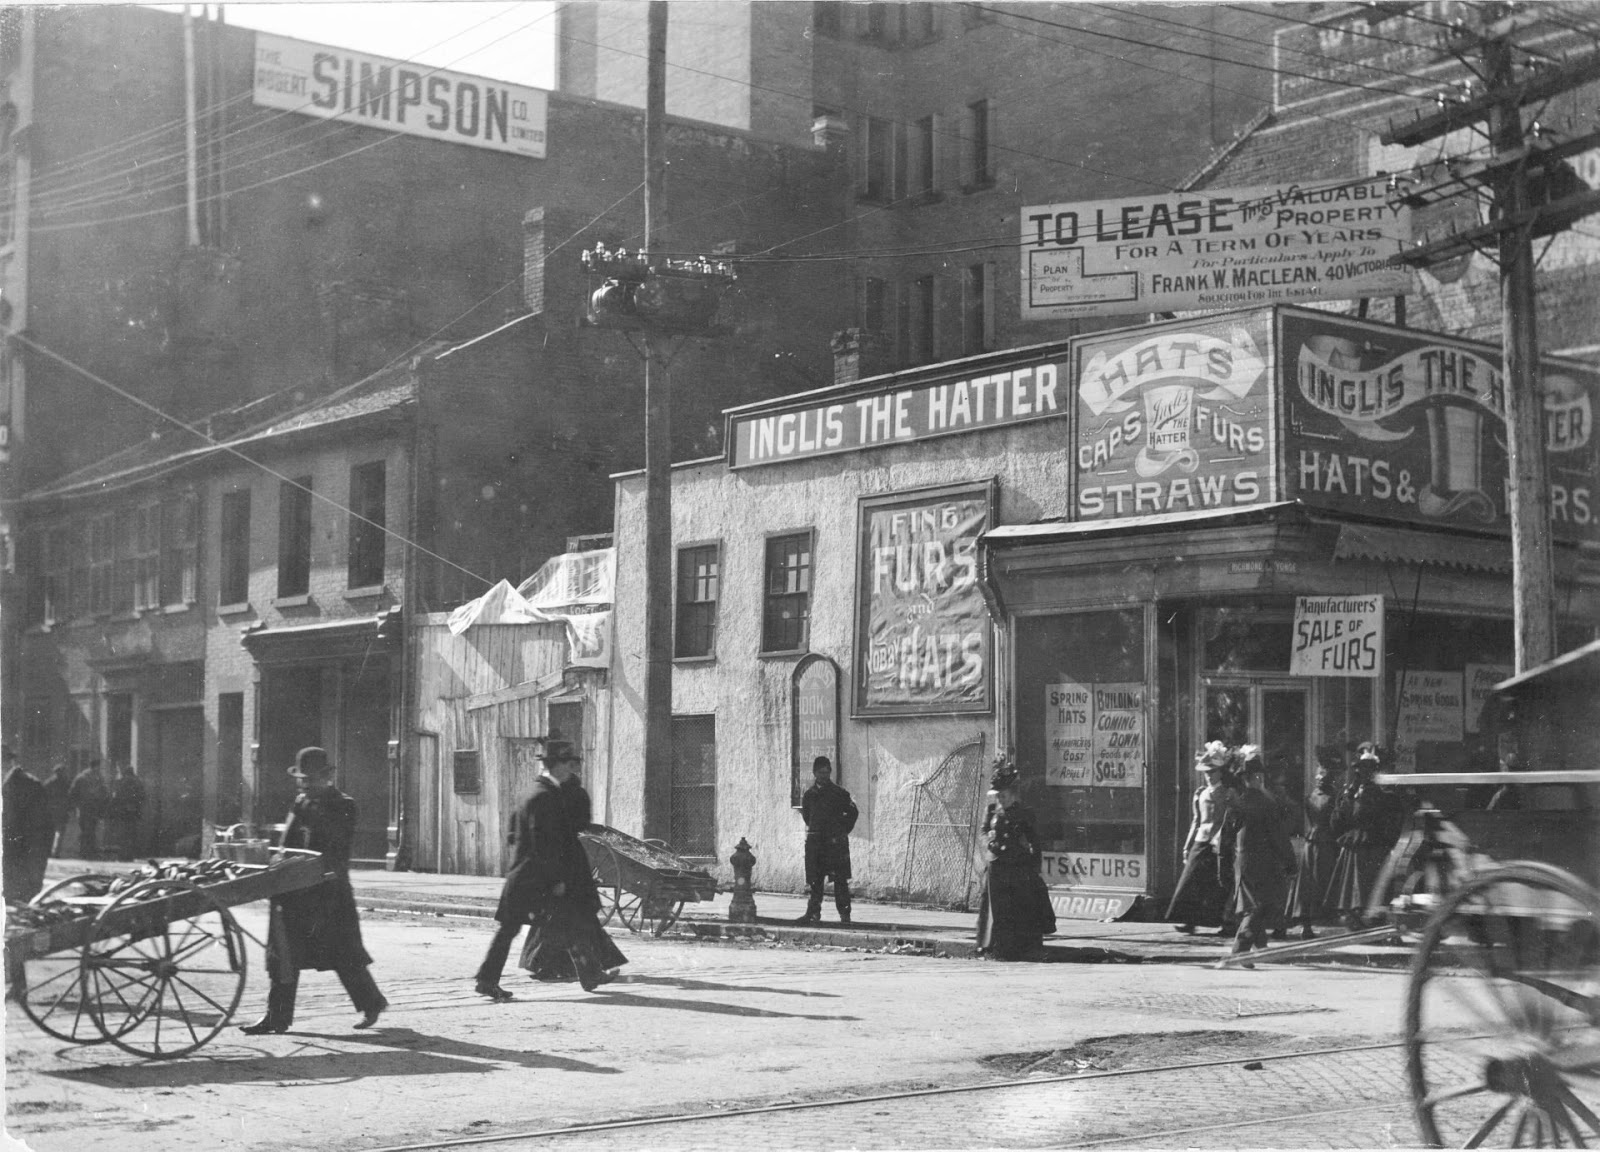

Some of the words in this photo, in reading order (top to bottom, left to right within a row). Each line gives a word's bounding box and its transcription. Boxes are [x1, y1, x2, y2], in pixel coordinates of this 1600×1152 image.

[311, 52, 508, 143] SIMPSON
[1029, 211, 1079, 247] TO
[1096, 198, 1233, 242] LEASE
[1276, 184, 1399, 206] VALUABLE
[1274, 200, 1404, 230] PROPERTY
[1116, 244, 1157, 260] FOR
[1166, 239, 1183, 257] A
[1195, 236, 1256, 253] TERM
[1265, 232, 1296, 248] OF
[1302, 227, 1382, 245] YEARS
[1043, 265, 1068, 275] PLAN
[1152, 274, 1208, 293] FRANK
[1213, 268, 1230, 289] W.
[1040, 284, 1074, 294] PROPERTY
[1100, 341, 1234, 397] HATS
[1307, 362, 1406, 417] INGLIS
[1420, 350, 1478, 395] THE
[749, 404, 843, 459] INGLIS
[857, 391, 912, 444] THE
[928, 363, 1058, 430] HATTER
[1173, 418, 1188, 429] THE
[1078, 411, 1142, 470] CAPS
[1149, 431, 1188, 449] HATTER
[1196, 405, 1266, 452] FURS
[1300, 450, 1391, 499] HATS
[1079, 471, 1261, 516] STRAWS
[892, 506, 958, 535] FINE
[873, 537, 977, 595] FURS
[907, 592, 934, 624] and
[1296, 619, 1343, 652] SALE
[1349, 619, 1364, 633] OF
[1321, 631, 1377, 671] FURS
[900, 623, 983, 688] HATS
[1050, 691, 1088, 707] SPRING
[1097, 689, 1139, 711] BUILDING
[803, 720, 834, 740] ROOM
[1059, 707, 1086, 724] HATS
[1098, 714, 1136, 731] COMING
[1063, 749, 1085, 761] COST
[1096, 760, 1126, 782] SOLD
